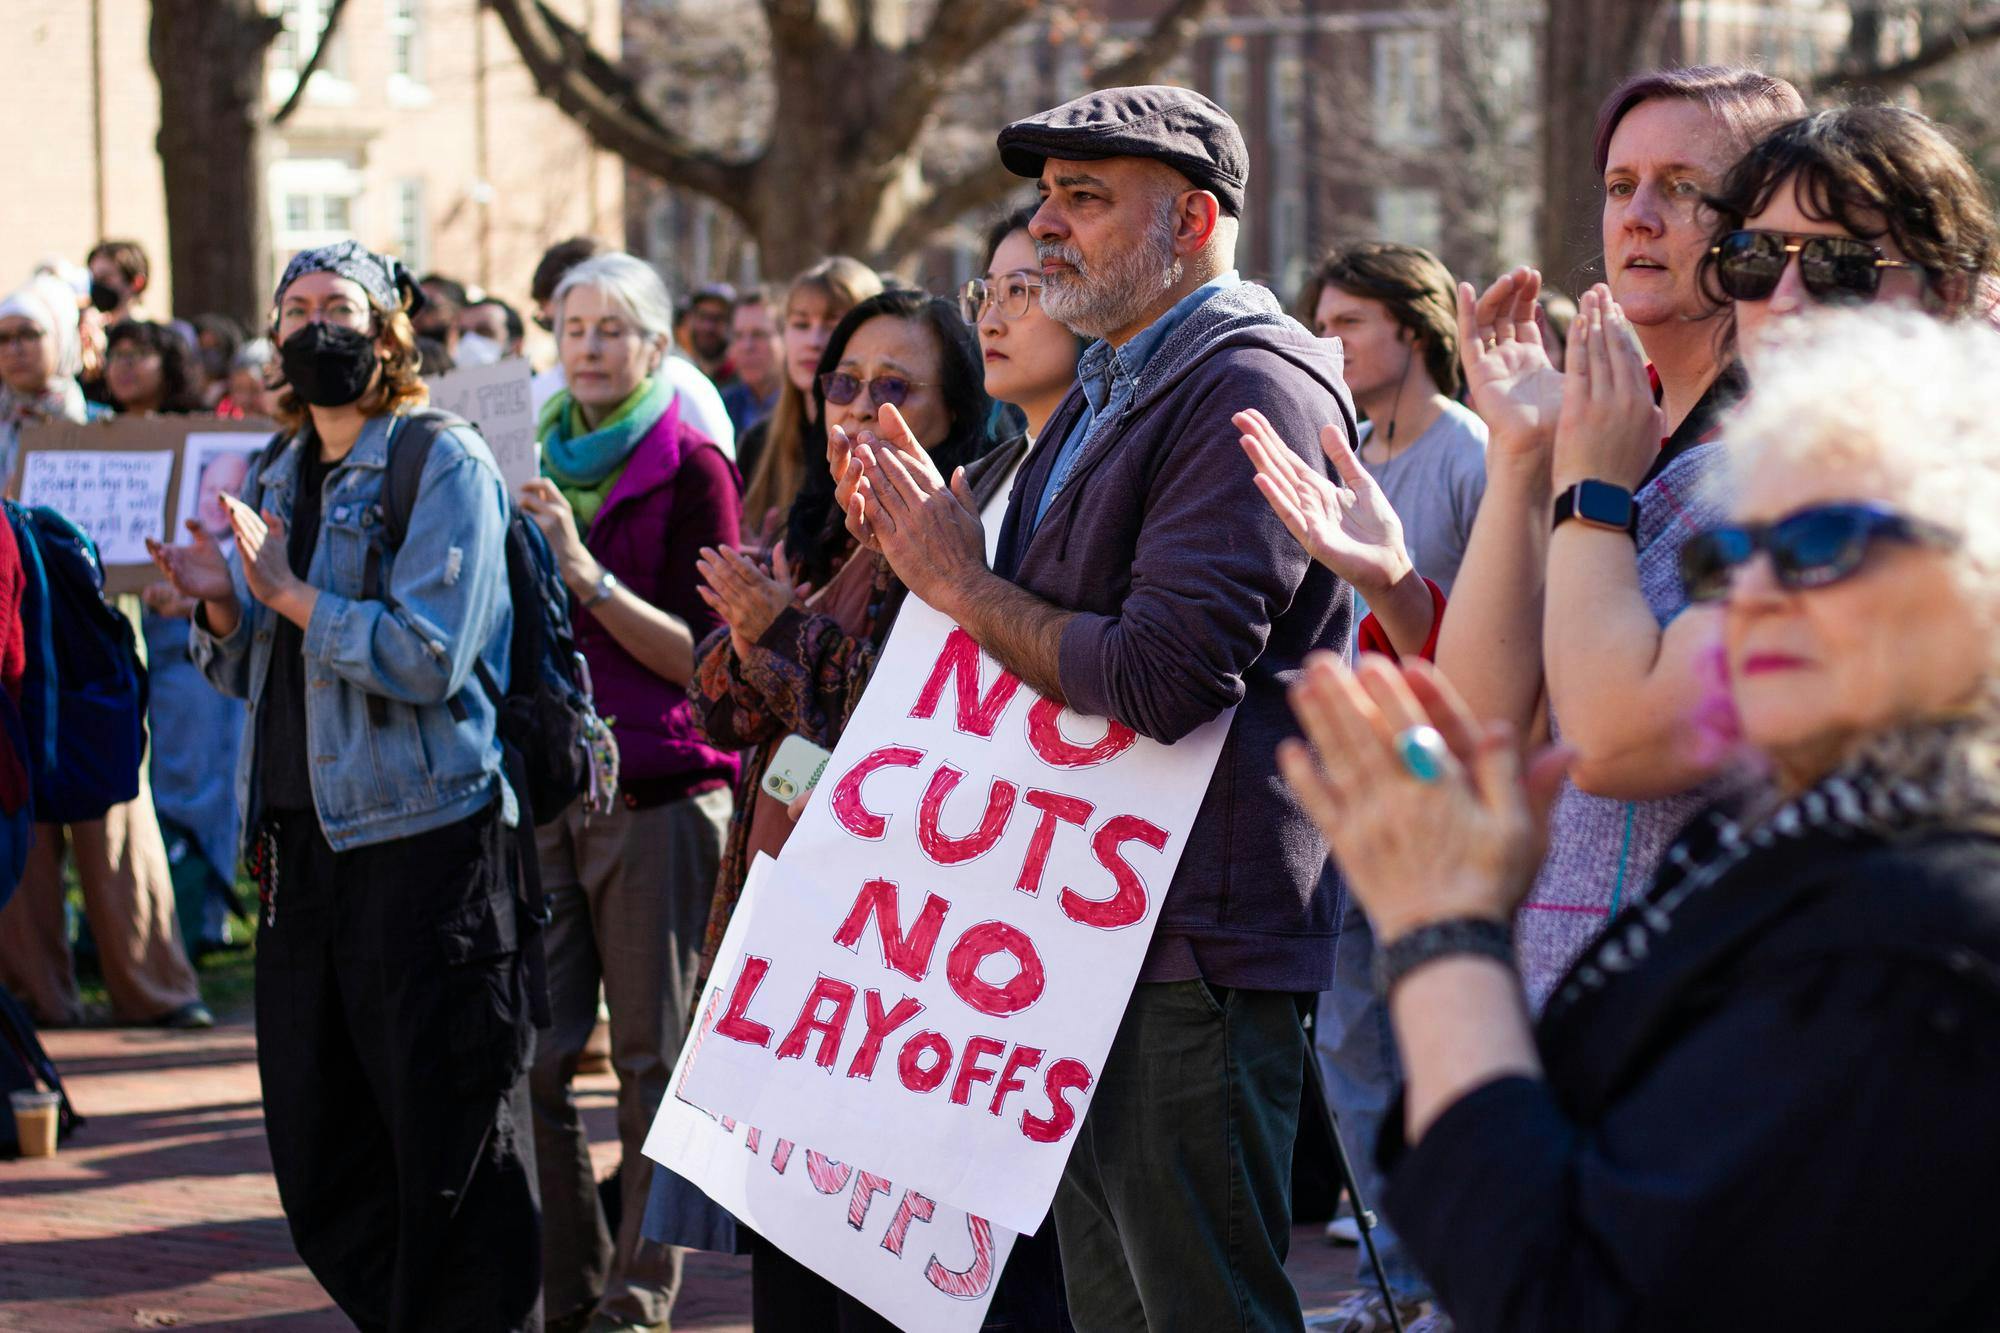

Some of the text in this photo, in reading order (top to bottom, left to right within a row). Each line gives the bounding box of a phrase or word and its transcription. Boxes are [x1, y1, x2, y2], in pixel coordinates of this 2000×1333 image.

[907, 625, 1139, 770] NO
[831, 743, 1171, 931] CUTS
[833, 877, 1047, 1017] NO
[713, 953, 1094, 1142] LAYOFFS
